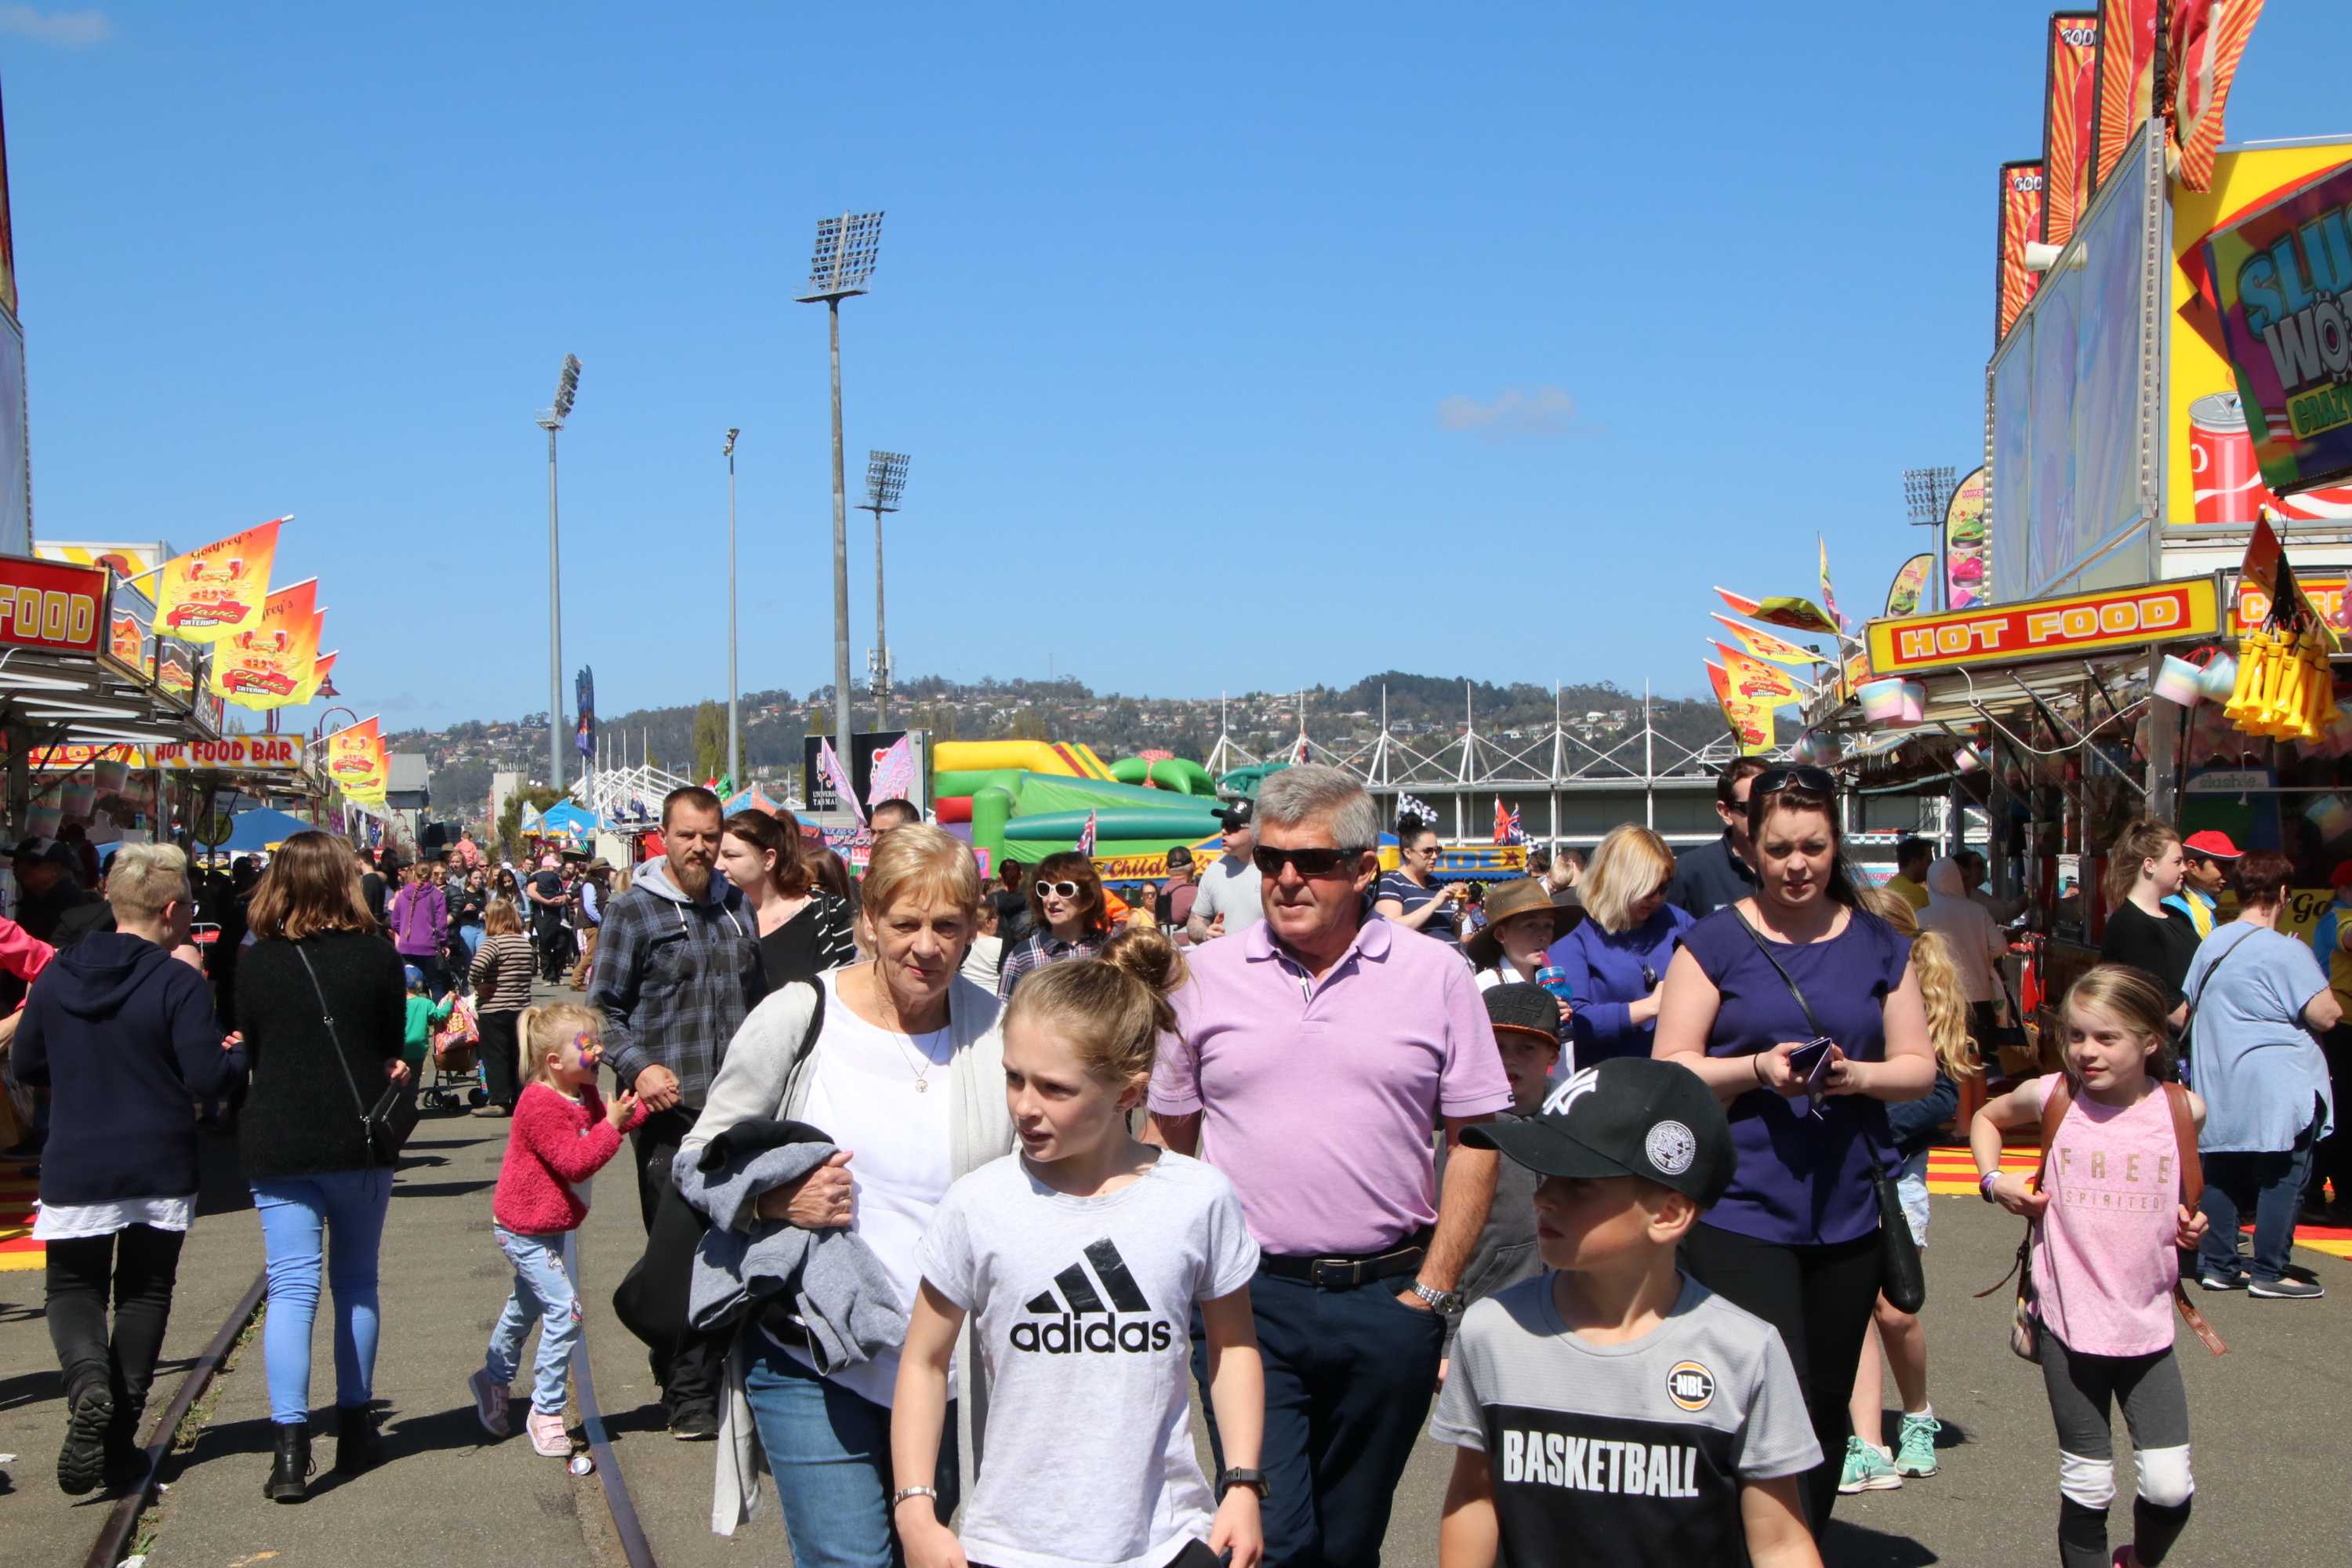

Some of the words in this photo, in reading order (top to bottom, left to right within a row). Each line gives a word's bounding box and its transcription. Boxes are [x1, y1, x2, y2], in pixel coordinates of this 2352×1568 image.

[2062, 28, 2096, 47] GOD
[2238, 201, 2352, 340] SLU
[2262, 289, 2352, 390] WO
[1900, 618, 2008, 659] HOT
[2026, 595, 2180, 643] FOOD
[192, 740, 245, 761] FOOD
[251, 741, 292, 760] BAR
[2060, 1148, 2171, 1183] FREE
[2065, 1191, 2159, 1210] SPIRITED
[1010, 1312, 1171, 1354] adidas
[1676, 1374, 1705, 1397] NBL
[1503, 1429, 1700, 1497] BASKETBALL
